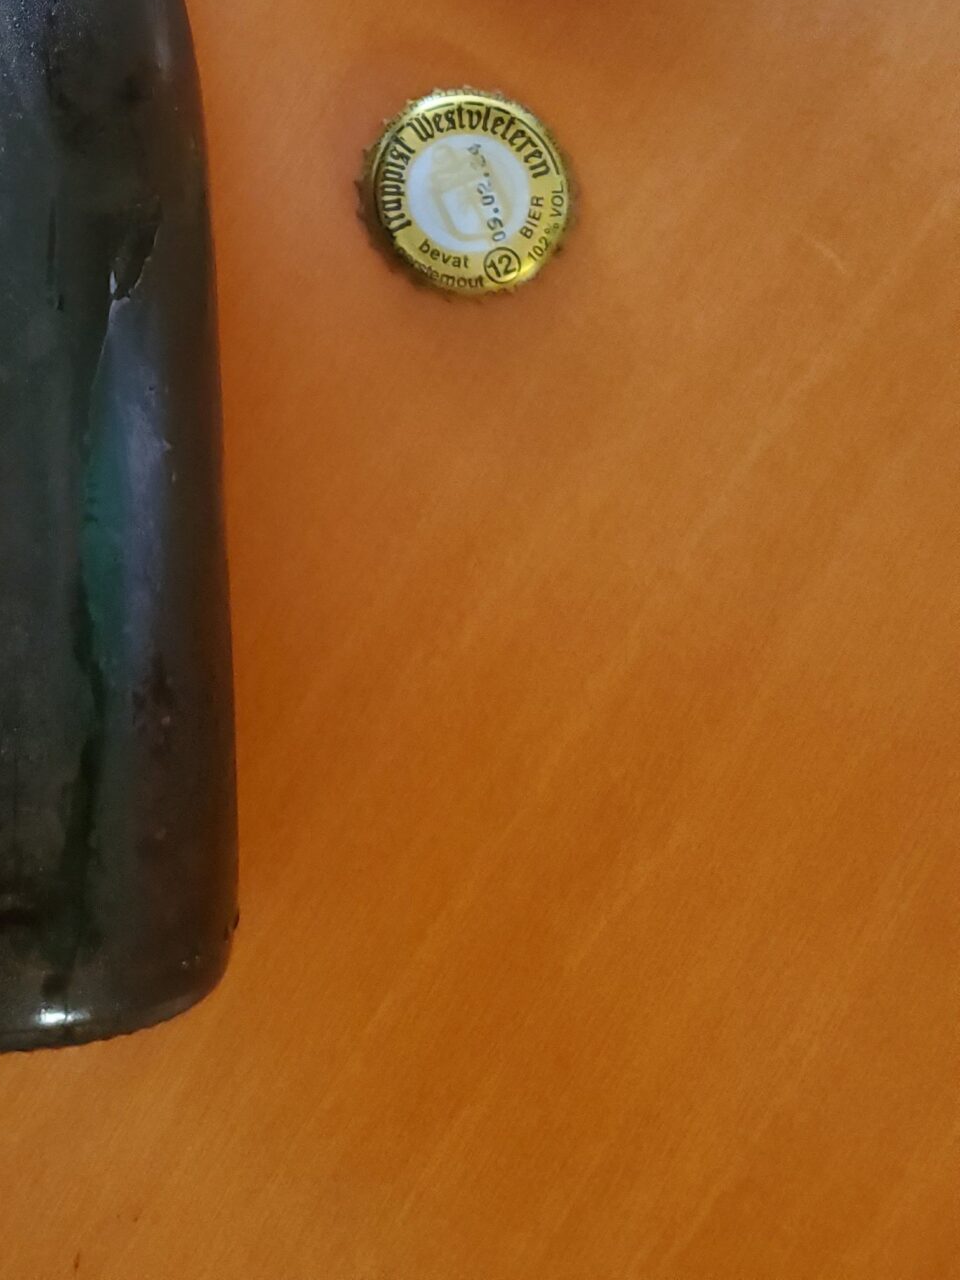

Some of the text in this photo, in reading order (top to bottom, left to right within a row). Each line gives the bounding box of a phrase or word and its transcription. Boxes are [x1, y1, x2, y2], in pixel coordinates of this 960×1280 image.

[381, 131, 417, 239] Trappist
[406, 104, 552, 180] Westvleteren
[519, 195, 545, 240] BIER
[549, 181, 565, 218] VOL
[418, 238, 470, 269] bevat
[486, 252, 518, 280] 12
